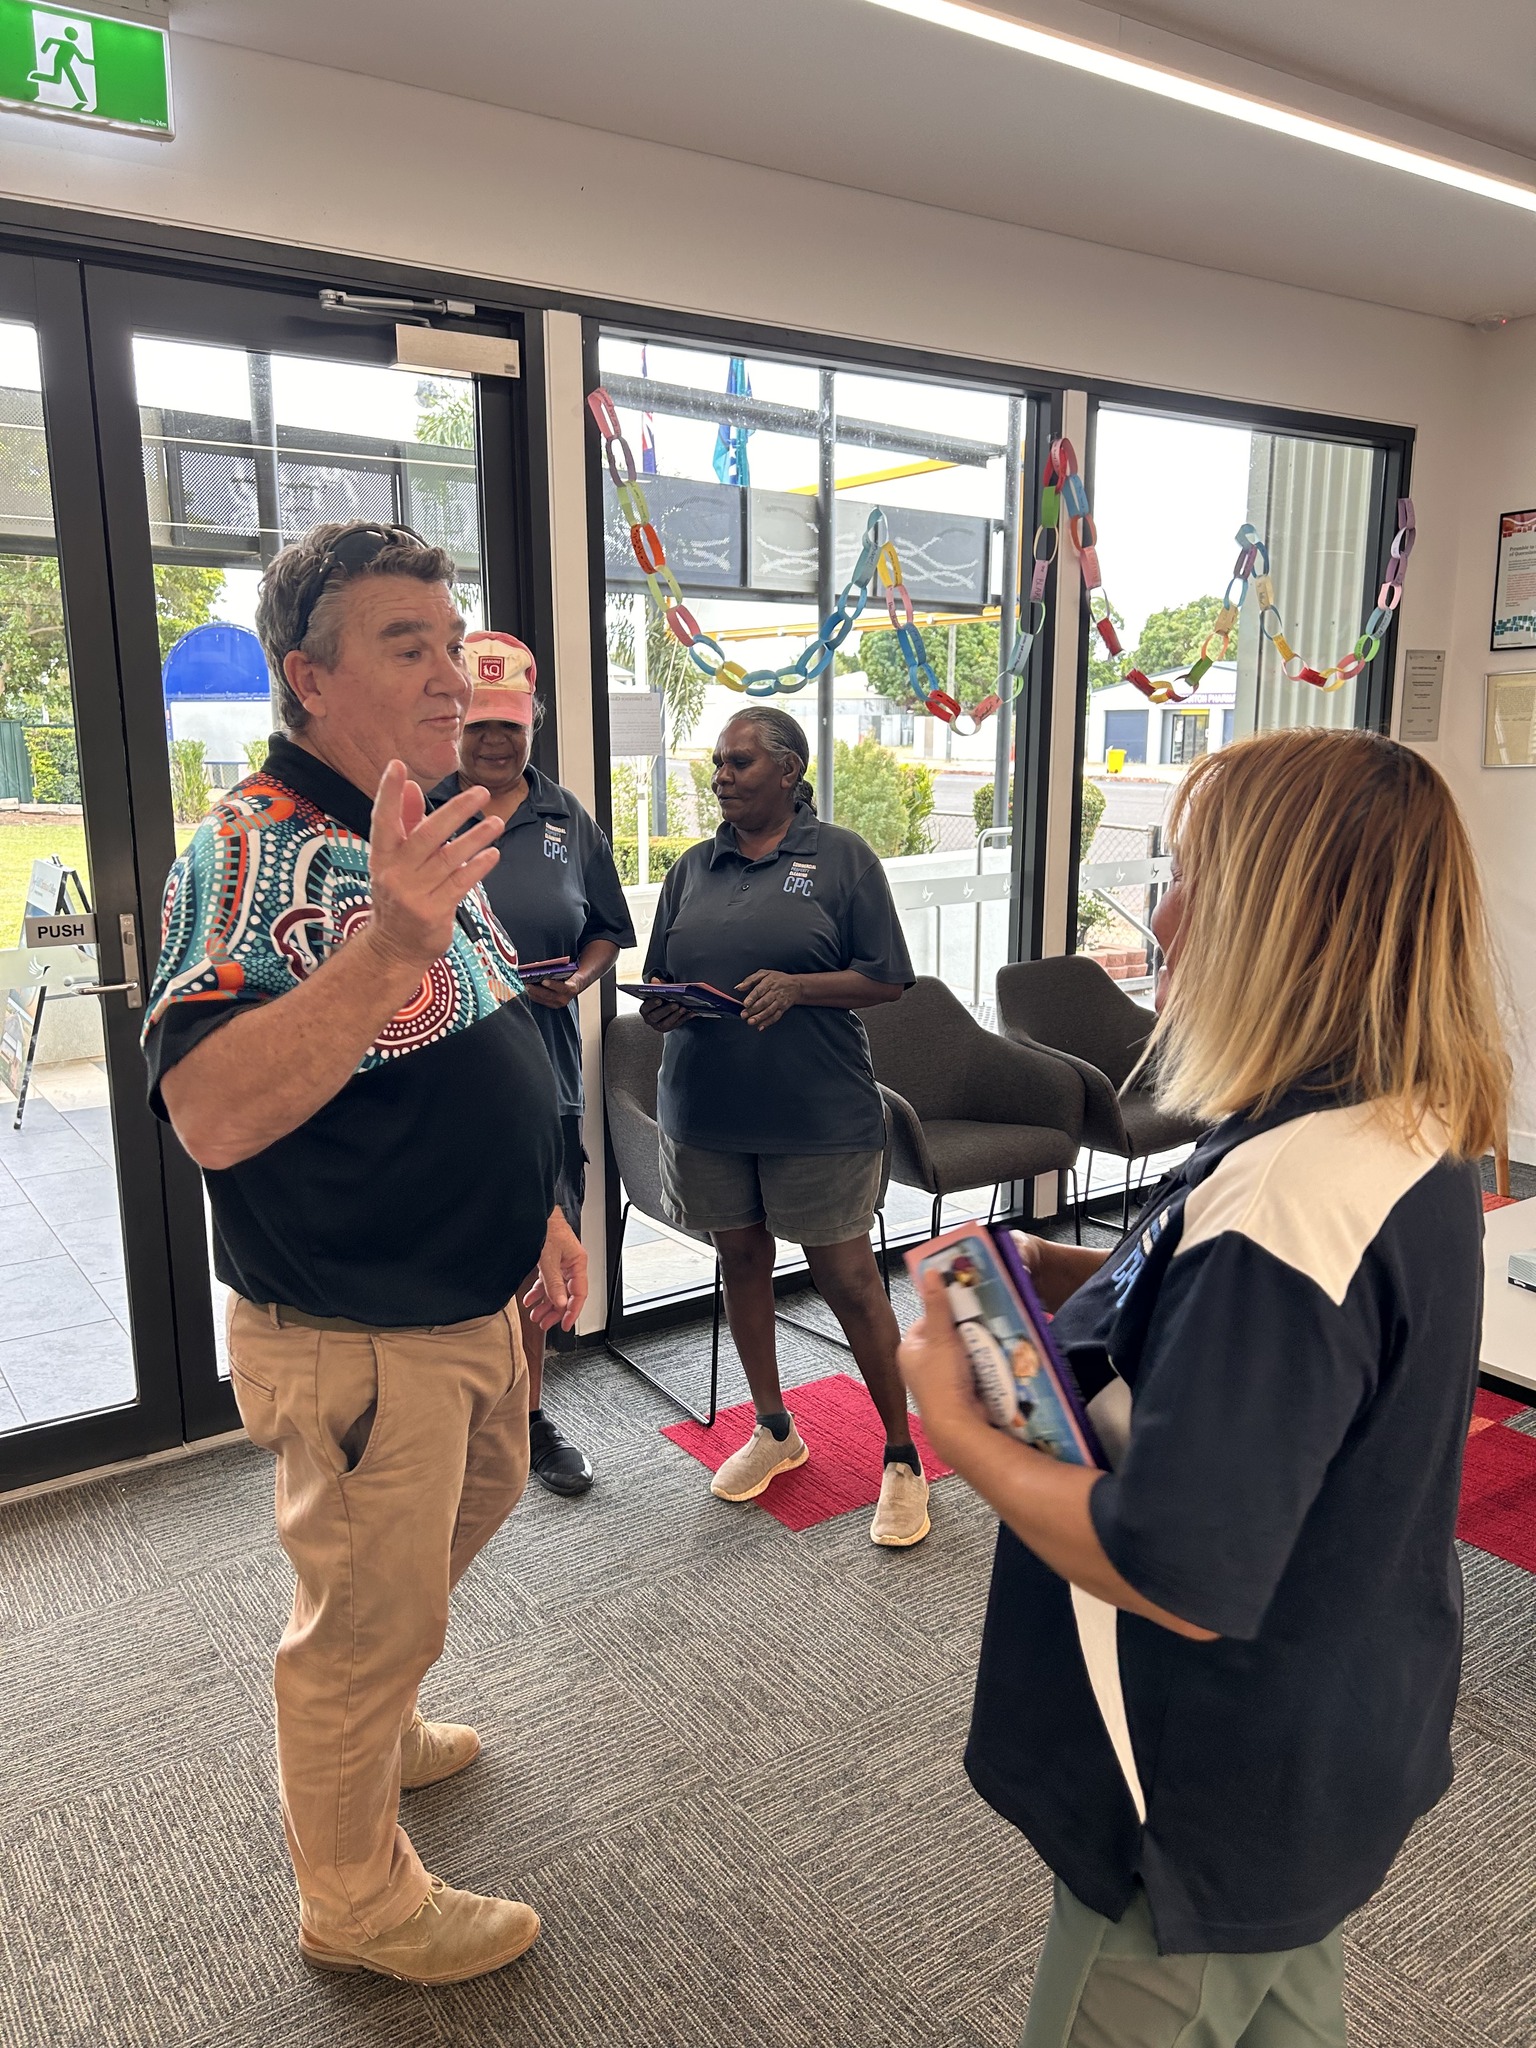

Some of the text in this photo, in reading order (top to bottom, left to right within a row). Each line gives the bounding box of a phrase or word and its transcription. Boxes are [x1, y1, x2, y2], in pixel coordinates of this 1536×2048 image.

[543, 839, 568, 864] CPC
[783, 876, 814, 897] CPC
[37, 923, 85, 939] PUSH
